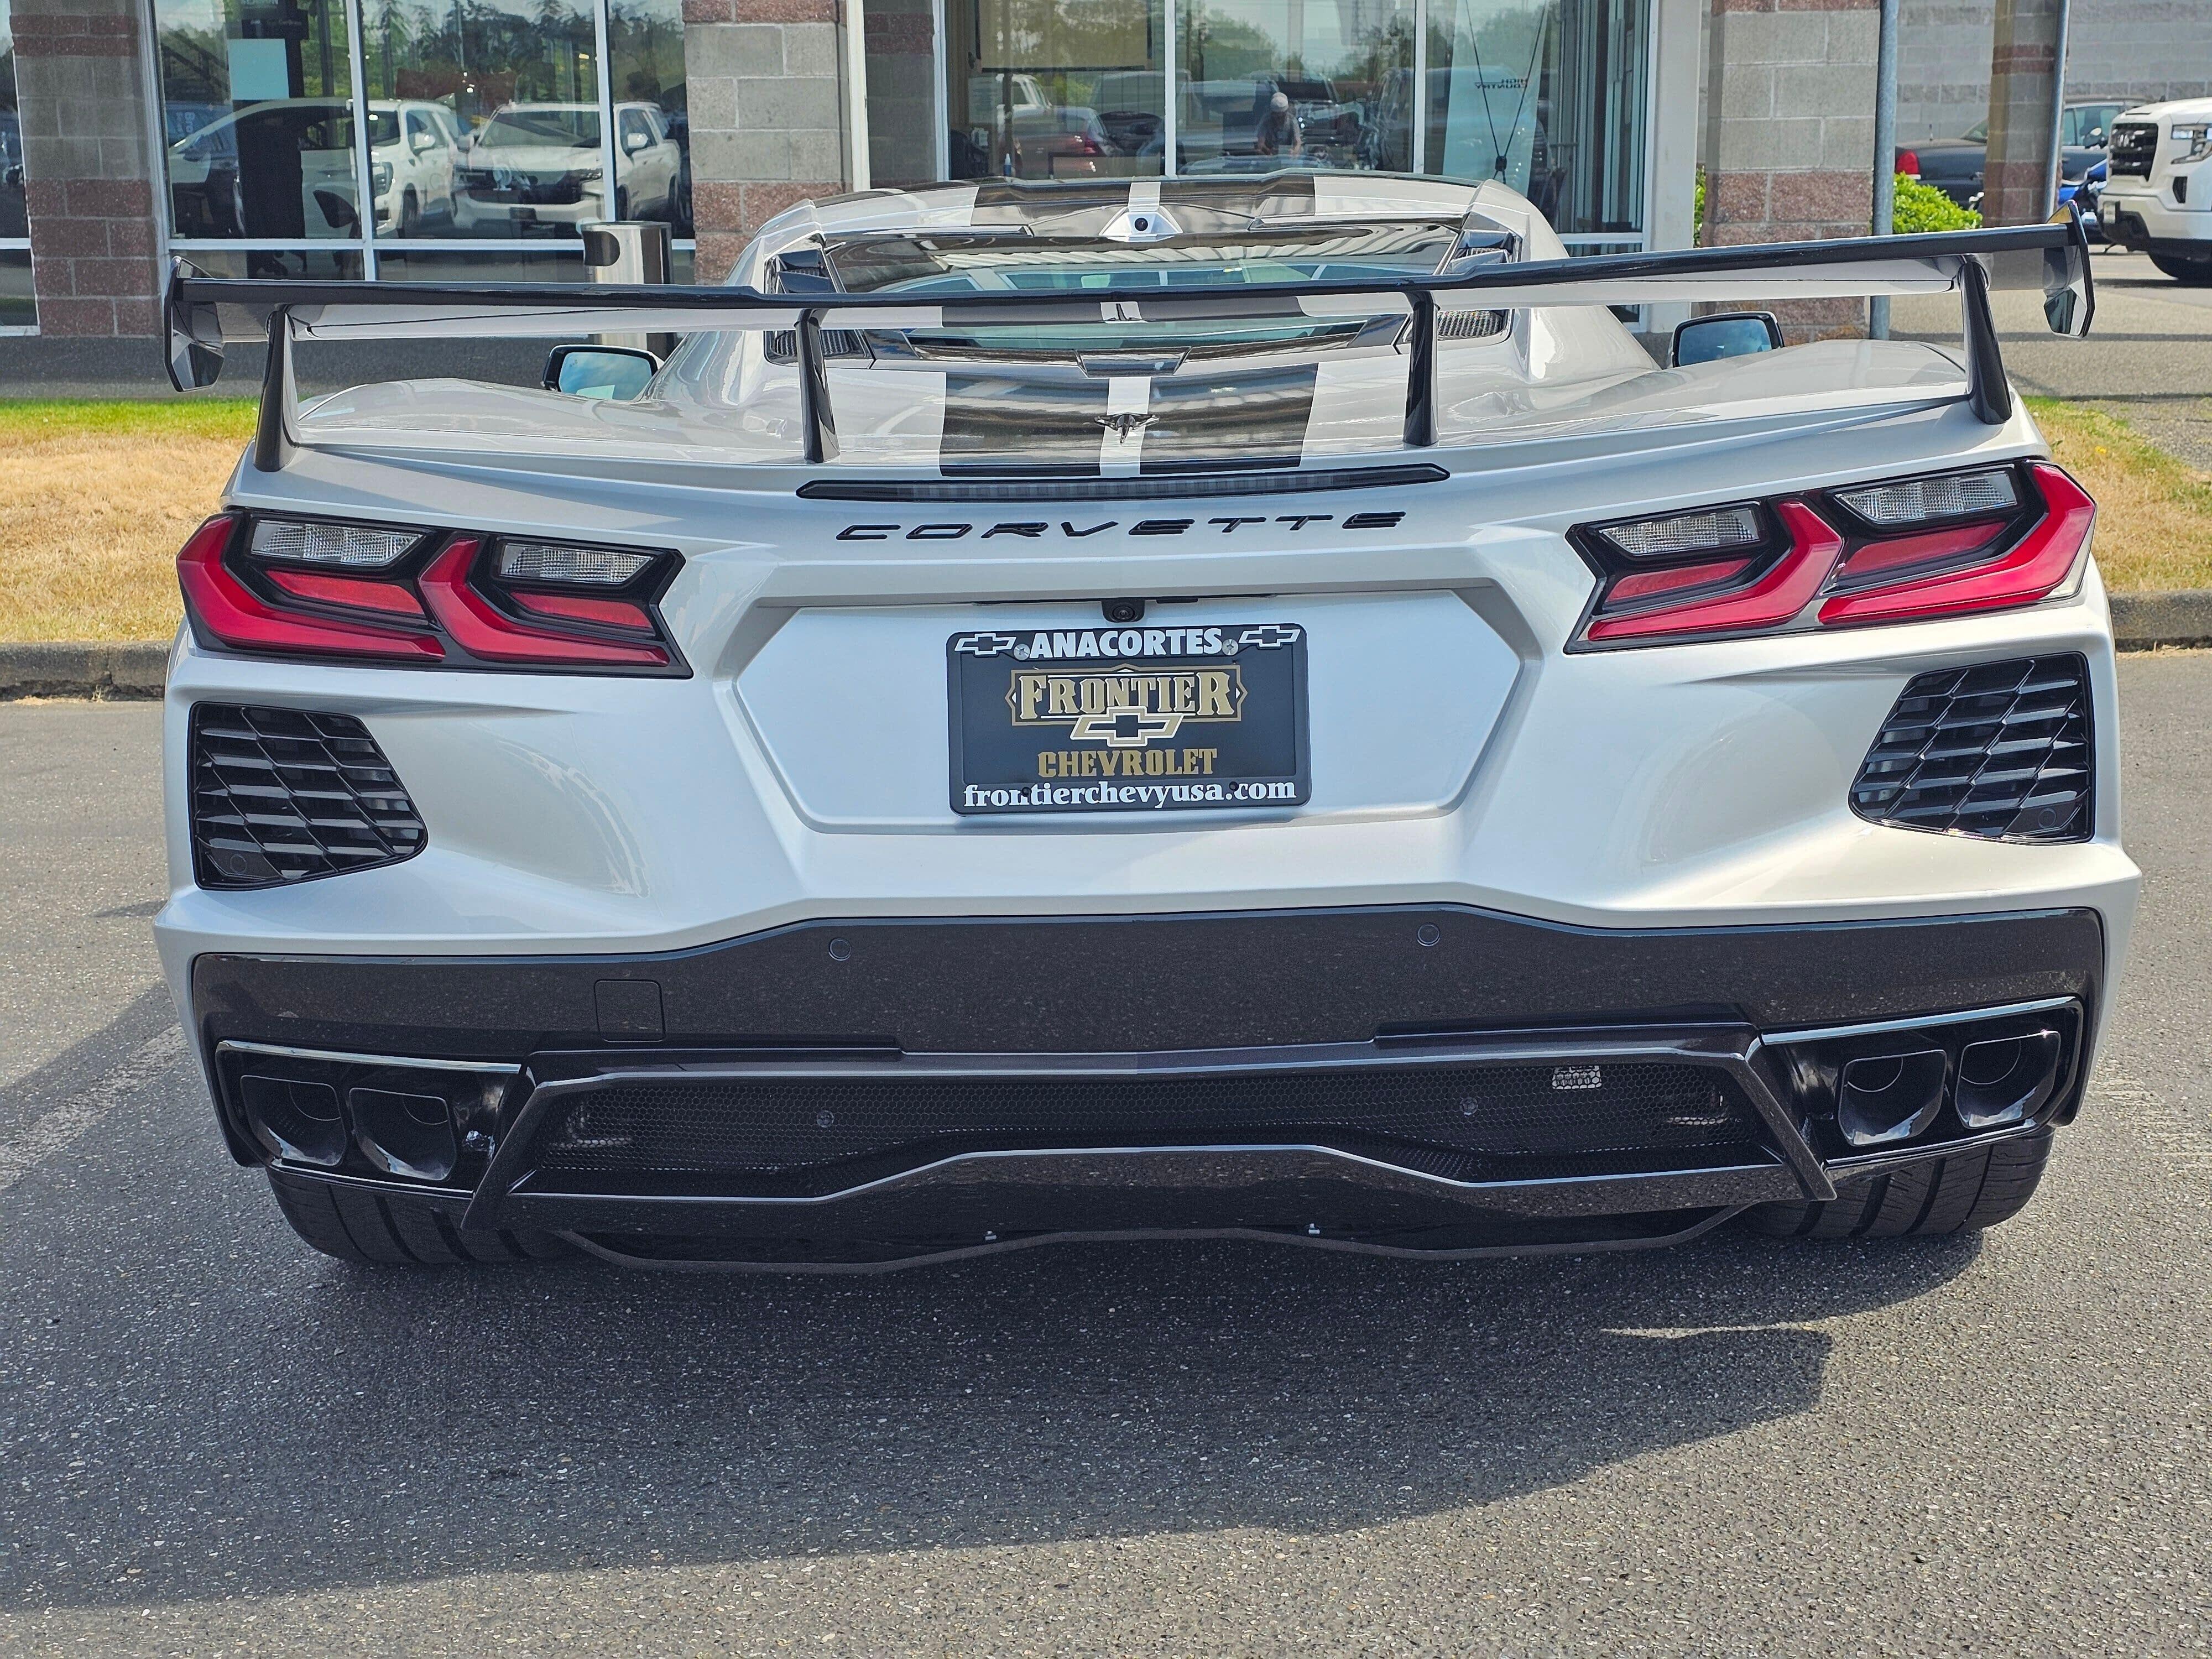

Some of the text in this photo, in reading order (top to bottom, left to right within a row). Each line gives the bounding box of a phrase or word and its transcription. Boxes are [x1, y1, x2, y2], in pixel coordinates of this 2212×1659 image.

[836, 511, 1407, 540] CORVETTE
[1029, 628, 1222, 659] ANACORTES
[1019, 671, 1234, 719] FRONTIER
[1037, 748, 1217, 777] CHEVROLET
[963, 781, 1296, 808] frontierchevyusa.com
